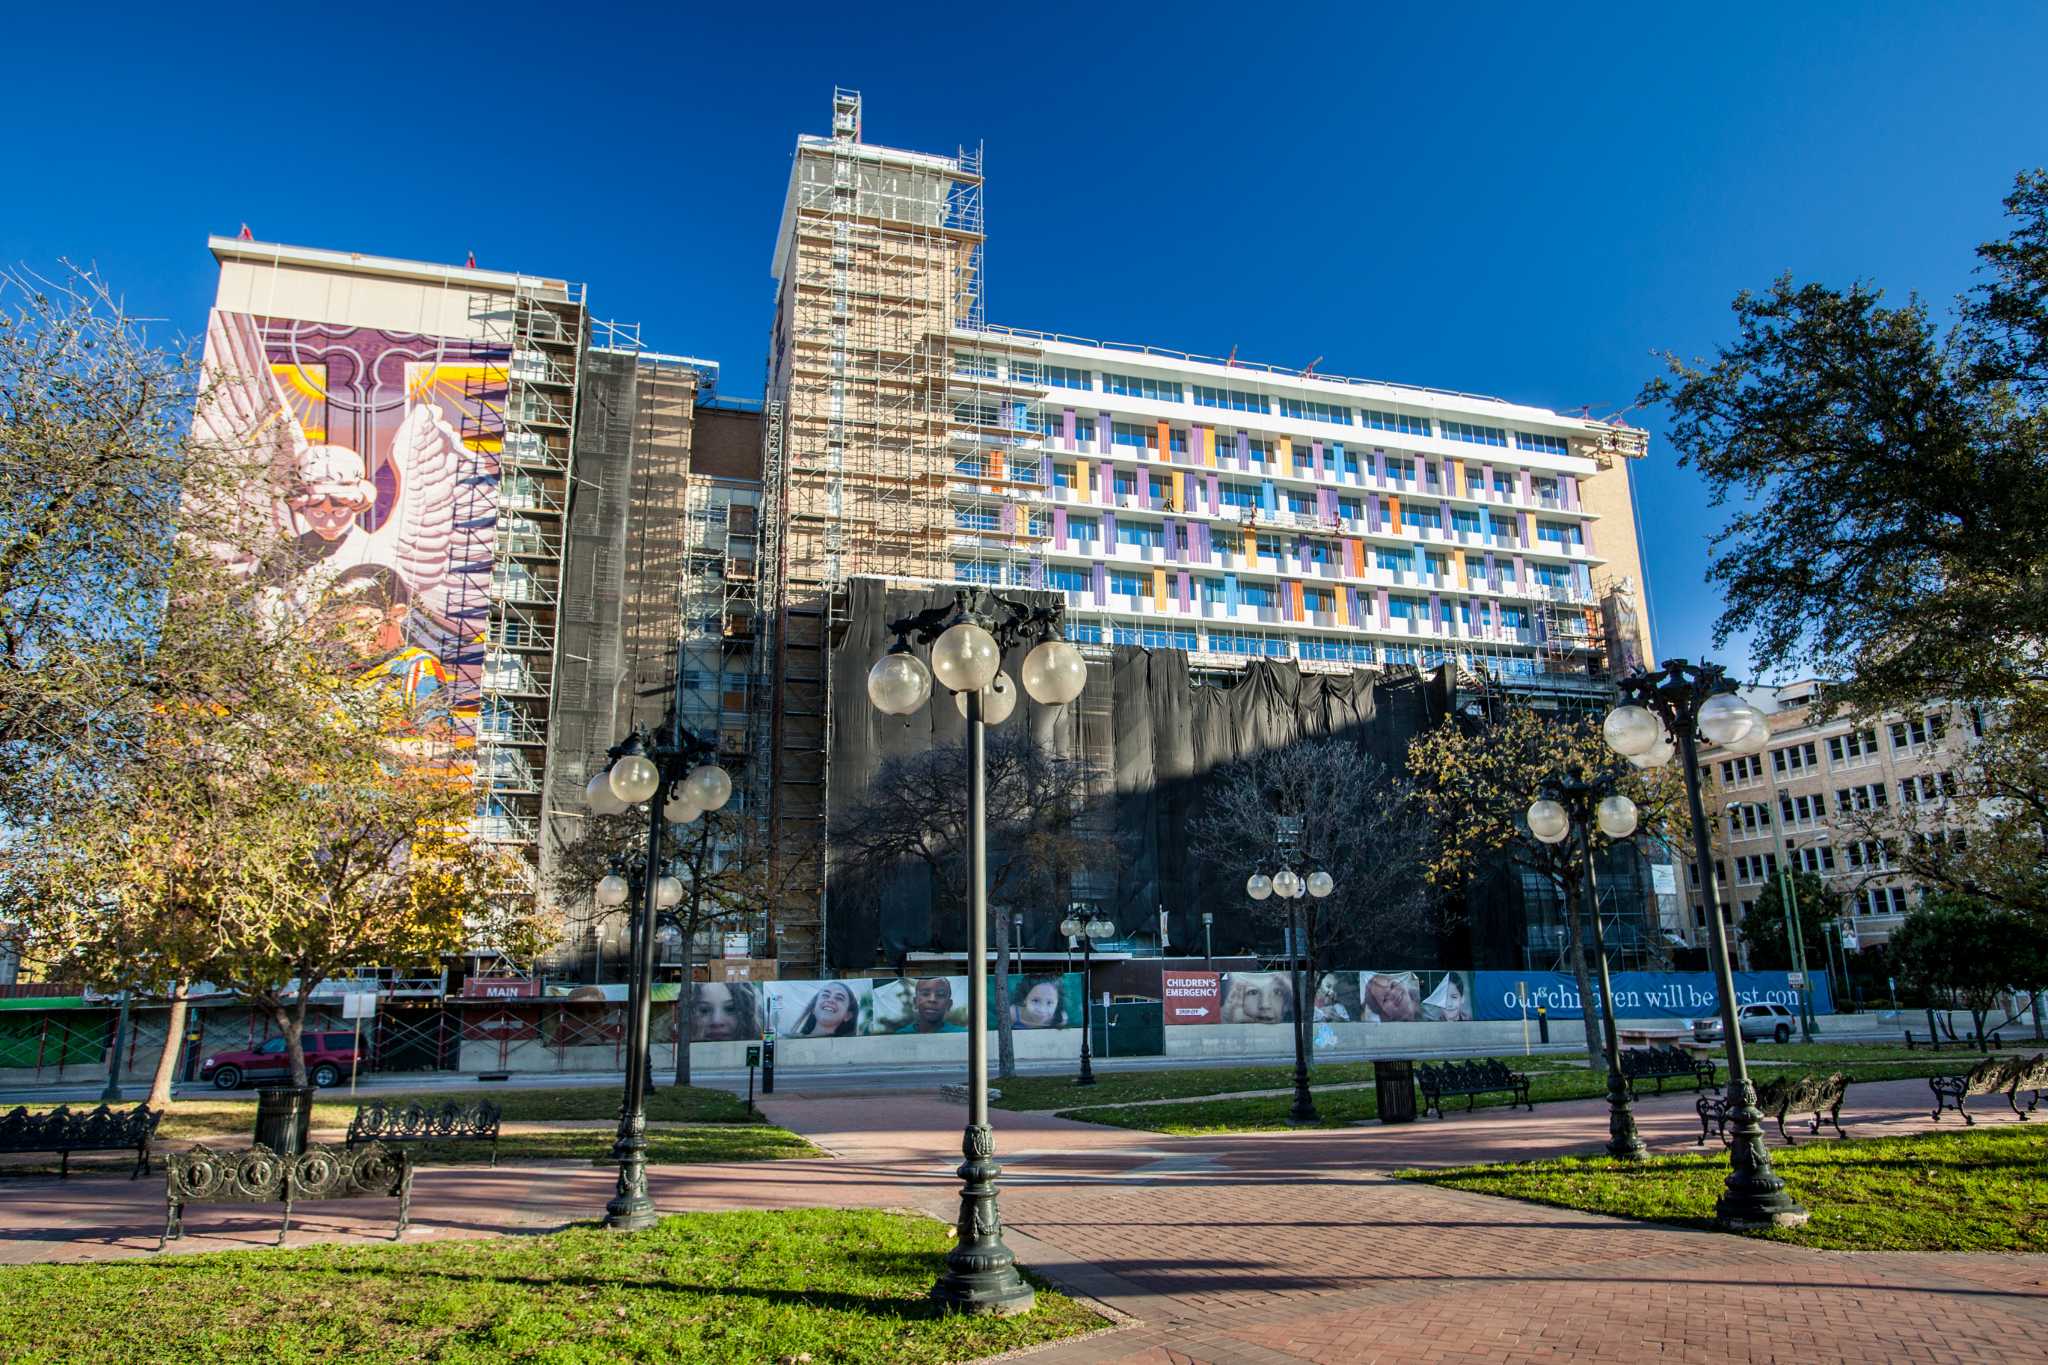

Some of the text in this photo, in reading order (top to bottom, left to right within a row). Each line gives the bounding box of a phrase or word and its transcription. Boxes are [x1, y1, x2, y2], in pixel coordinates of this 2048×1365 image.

[1166, 978, 1217, 987] CHILDREN'S
[487, 987, 518, 997] MAIN
[1165, 988, 1218, 997] EMERGENCY
[1548, 984, 1641, 1009] chiden
[1644, 984, 1685, 1008] will
[1688, 984, 1715, 1008] be
